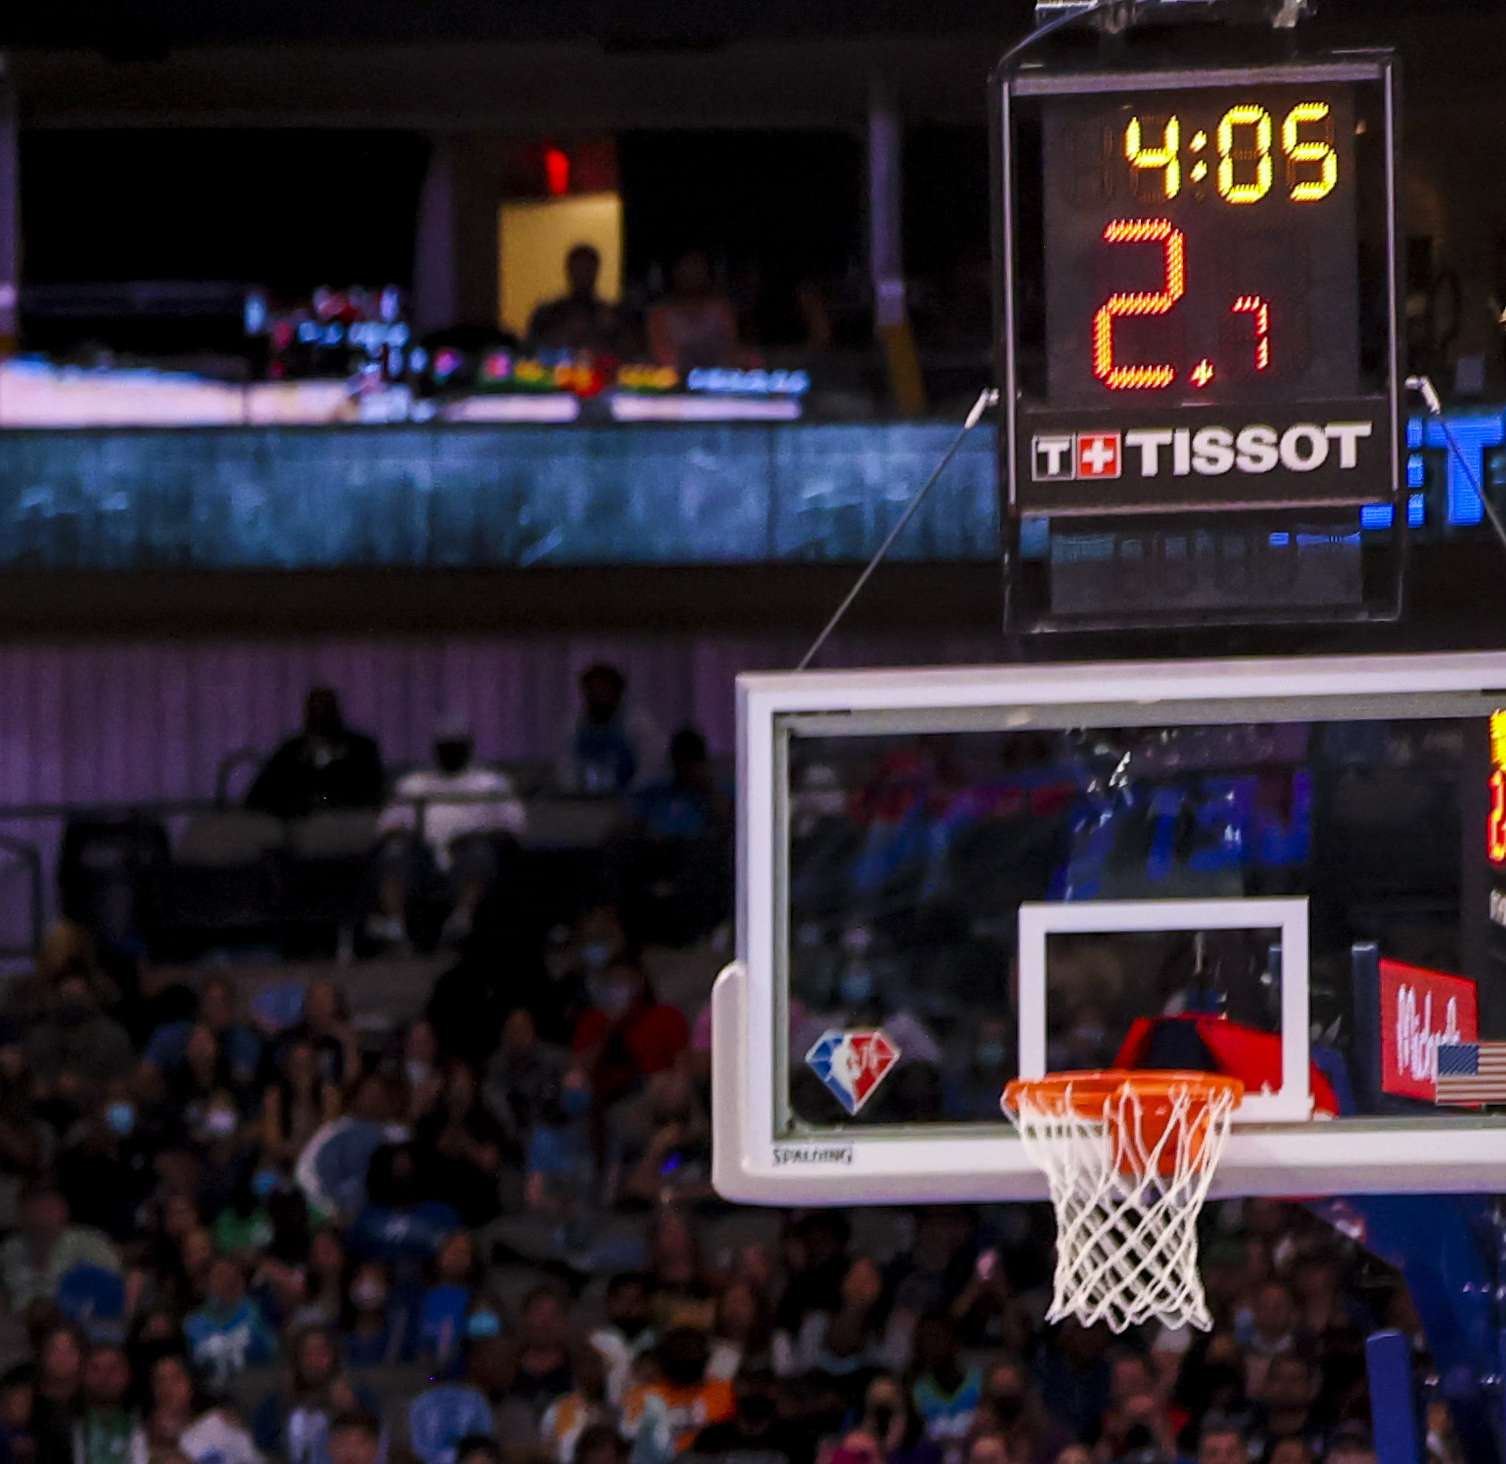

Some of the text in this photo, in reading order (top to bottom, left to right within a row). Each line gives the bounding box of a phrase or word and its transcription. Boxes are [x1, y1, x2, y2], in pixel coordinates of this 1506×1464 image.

[1124, 101, 1338, 204] 4:05
[1092, 218, 1270, 390] 2.7
[1125, 421, 1373, 479] TISSOT
